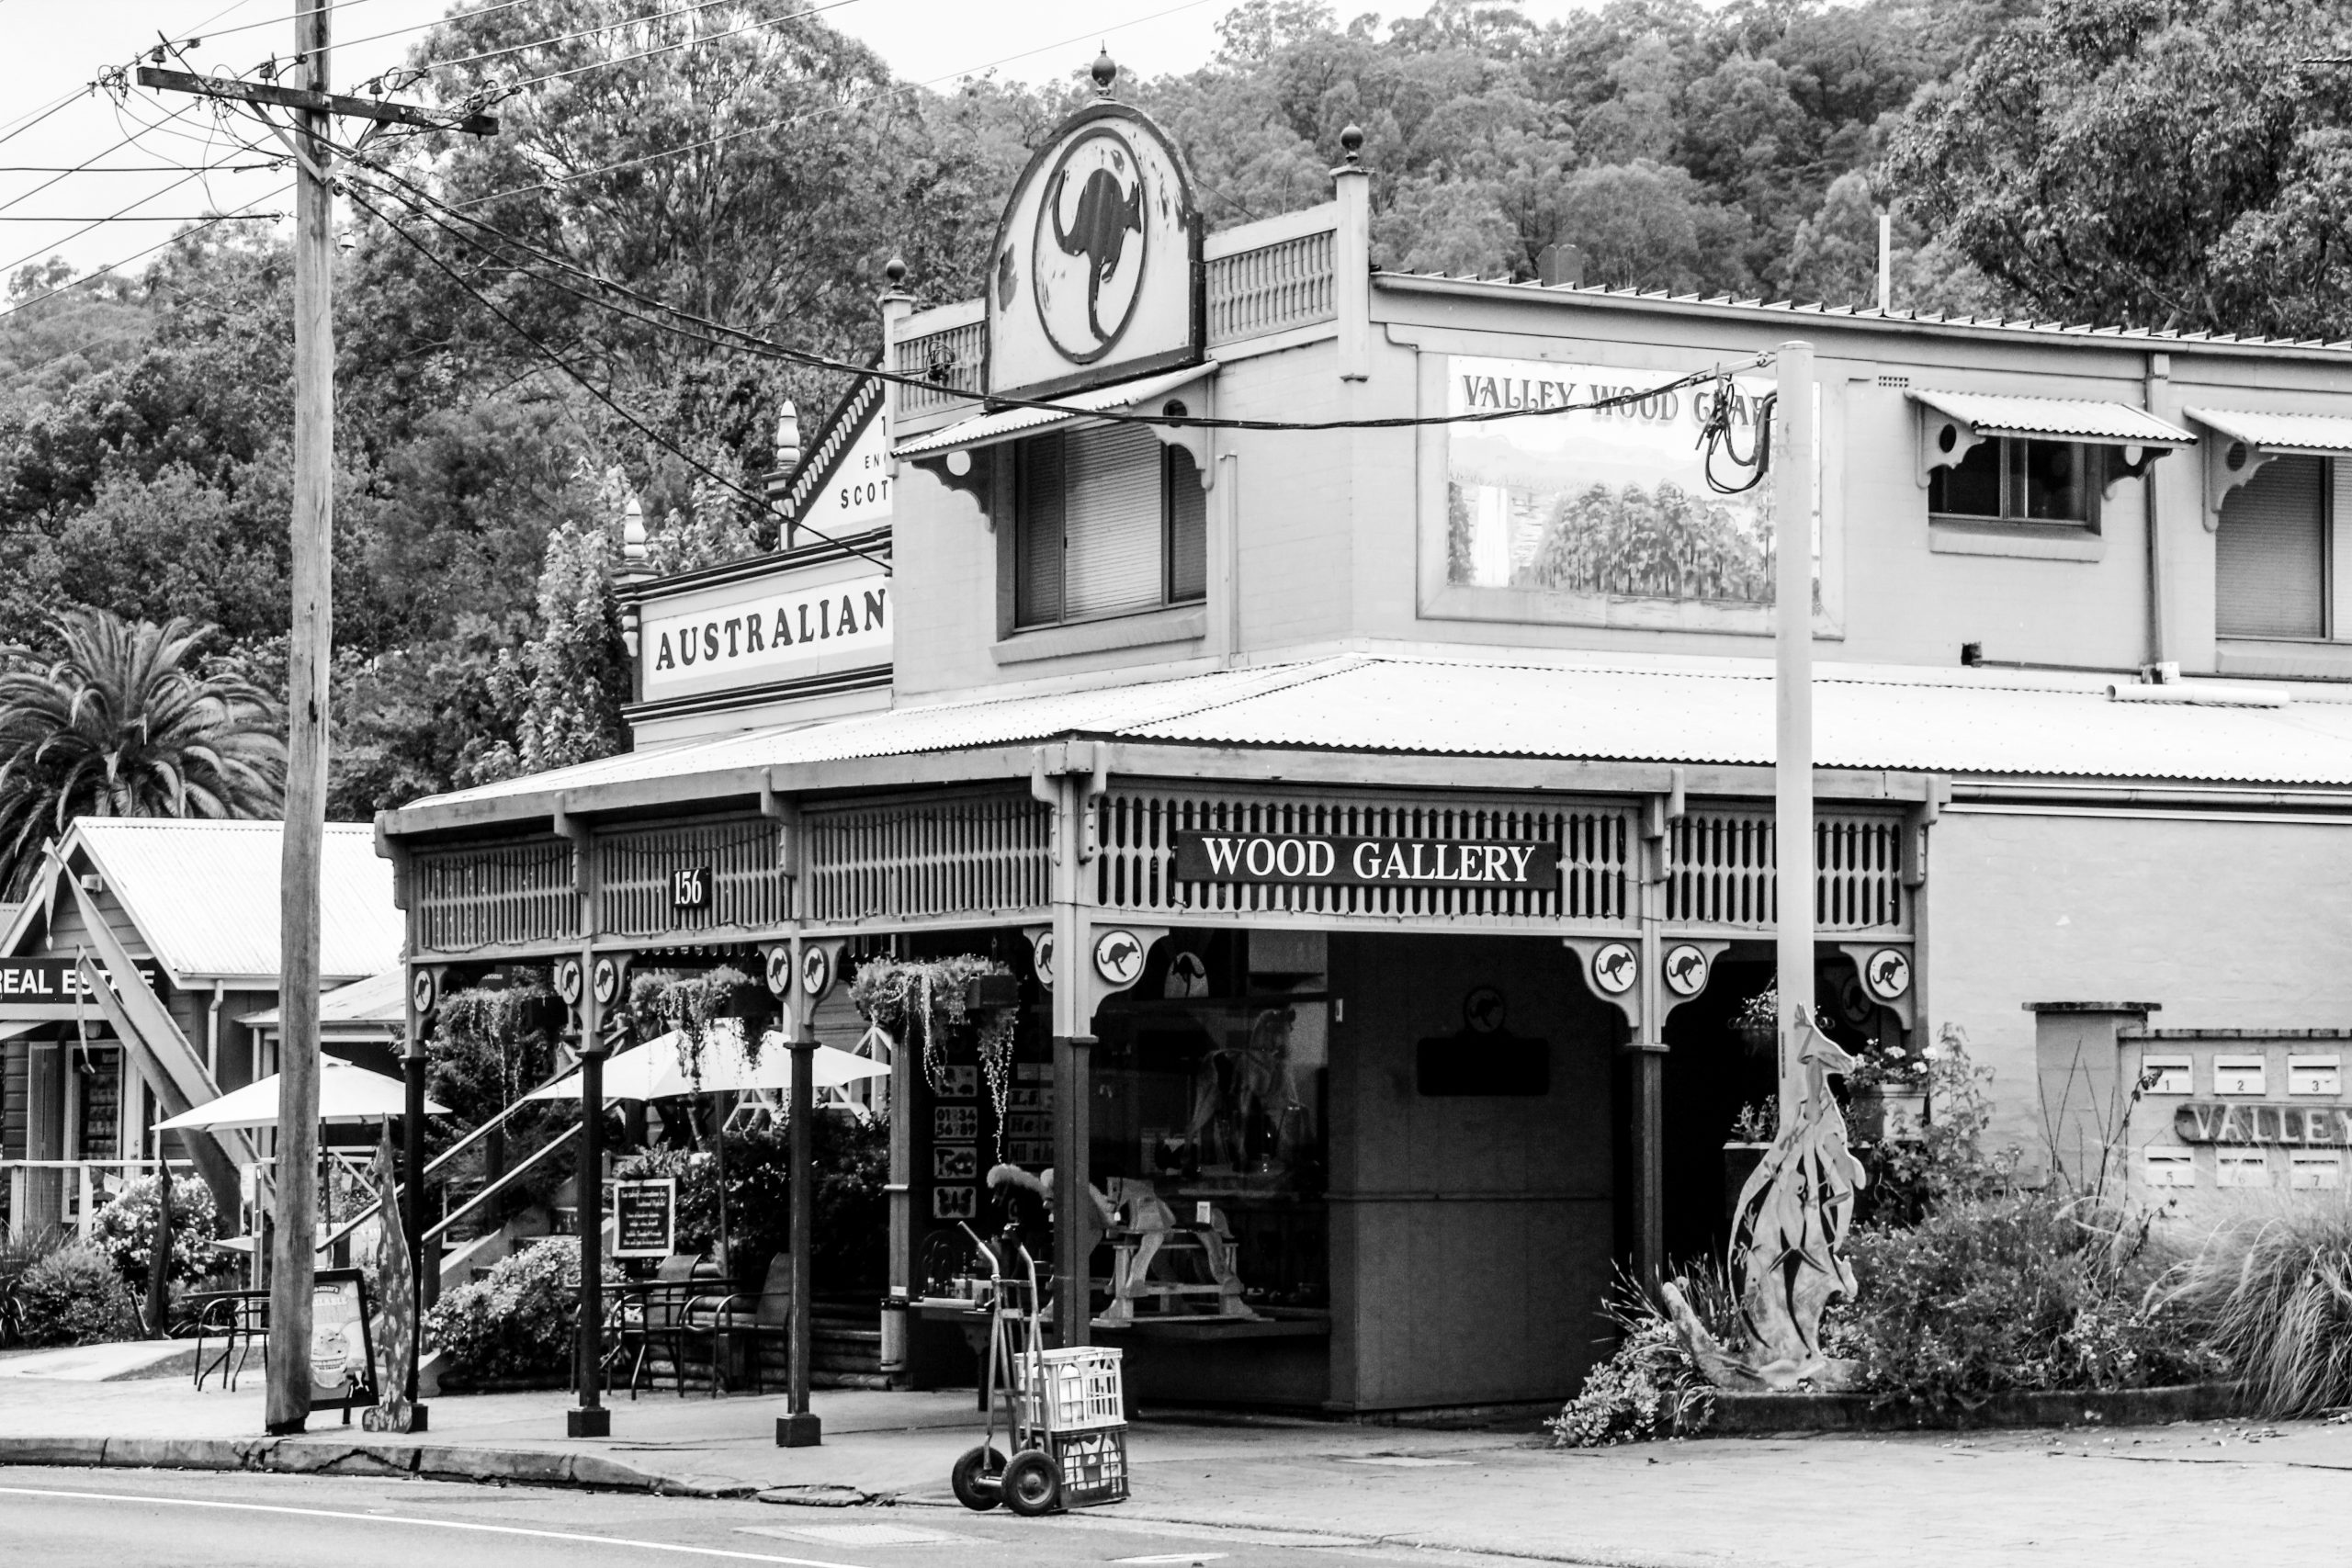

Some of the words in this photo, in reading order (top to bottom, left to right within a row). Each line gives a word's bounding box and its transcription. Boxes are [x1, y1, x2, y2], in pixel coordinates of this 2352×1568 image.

[1463, 375, 1577, 411] VALLEY
[1589, 384, 1679, 420] WOOD
[865, 453, 887, 469] EN
[656, 588, 886, 671] AUSTRALIAN
[1202, 837, 1335, 876] WOOD
[1352, 841, 1535, 882] GALLERY
[675, 869, 702, 905] 156
[0, 969, 53, 994] EAL
[2165, 1079, 2170, 1091] 1
[2237, 1079, 2245, 1091] 2
[2312, 1079, 2320, 1092] 3
[2313, 1175, 2321, 1187] 7
